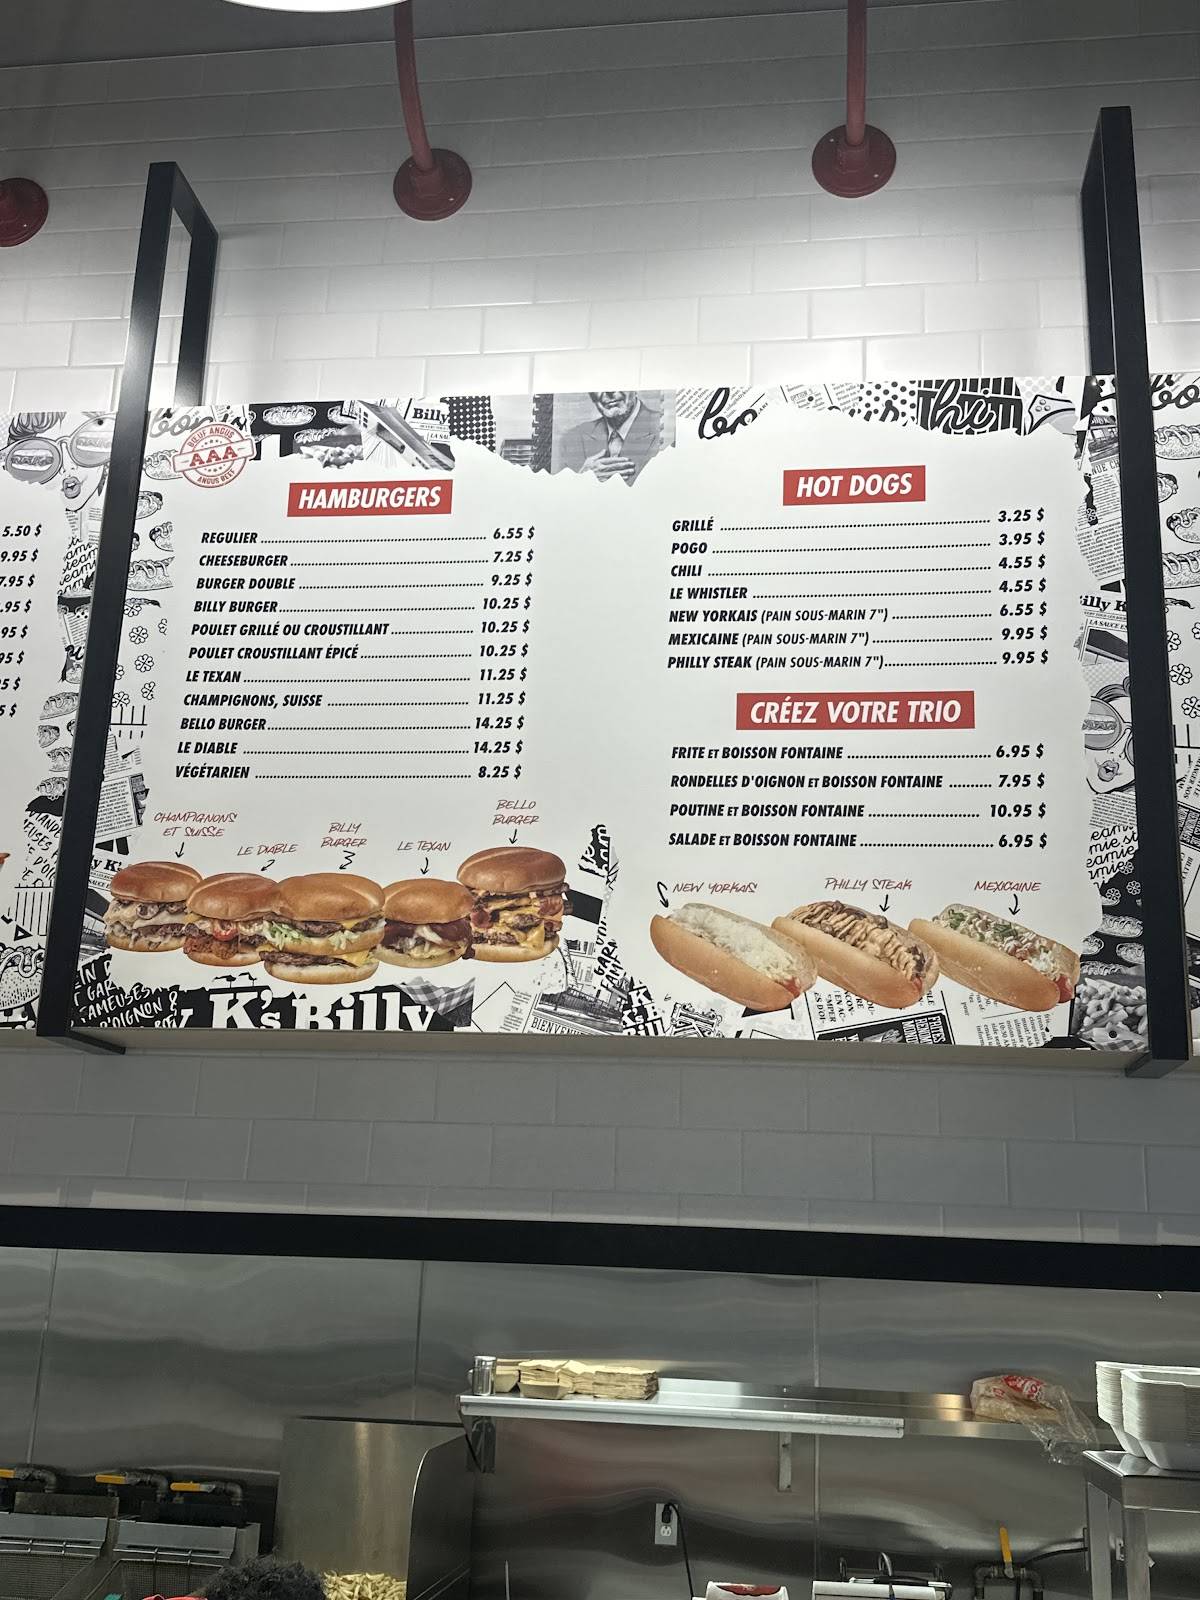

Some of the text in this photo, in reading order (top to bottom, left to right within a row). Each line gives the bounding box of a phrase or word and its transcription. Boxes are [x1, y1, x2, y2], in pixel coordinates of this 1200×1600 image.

[413, 408, 449, 424] Billy
[210, 427, 235, 438] ANGUS
[189, 446, 237, 466] AAA
[197, 469, 235, 484] ANGUS BEEF
[797, 473, 912, 497] HOT DOGS
[299, 486, 441, 509] HAMBURGERS
[673, 507, 1044, 531] GRILLÉ 3.25 $
[2, 524, 41, 537] 5.50 $
[201, 526, 534, 543] REGULIER 6.55 $
[672, 531, 1044, 554] POGO 3.95 $
[1, 549, 38, 562] 9.95 $
[200, 549, 533, 566] CHEESEBURGER 7.25 $
[671, 554, 1045, 576] CHILI 4.55 $
[28, 574, 35, 587] $
[197, 573, 532, 589] BURGER DOUBLE 9.25 $
[670, 578, 1046, 599] LE WHISTLER 4.55 $
[0, 599, 31, 613] .95 $
[194, 596, 531, 612] BILLY BURGER 10.25 $
[1080, 595, 1111, 612] illy
[669, 611, 698, 622] NEW
[703, 610, 757, 622] YORKAIS
[761, 610, 791, 624] (PAIN
[795, 610, 866, 621] SOUS-MARIN
[1000, 604, 1033, 616] 6.55
[1040, 601, 1046, 616] $
[21, 625, 28, 638] $
[192, 619, 529, 635] POULET GRILLÉ OU CROUSTILLANT 10.25 $
[668, 633, 739, 645] MEXICAINE
[743, 634, 772, 647] (PAIN
[777, 633, 847, 644] SOUS-MARIN
[1002, 627, 1034, 640] 9.95
[1040, 625, 1047, 640] $
[17, 651, 24, 664] $
[189, 643, 528, 659] POULET CROUSTILLANT ÉPICÉ 10.25 $
[668, 657, 710, 668] PHILLY
[714, 656, 752, 668] STEAK
[756, 657, 786, 670] (PAIN
[790, 657, 861, 667] SOUS-MARIN
[1003, 651, 1034, 664] 9.95
[1041, 649, 1048, 664] $
[186, 667, 527, 682] LE TEXAN 11.25 $
[13, 677, 20, 691] $
[184, 691, 525, 709] CHAMPIGNONS, SUISSE 11.25 $
[9, 703, 16, 717] $
[751, 696, 961, 723] CRÉEZ VOTRE TRIO
[180, 716, 524, 730] BELLO BURGER 14.25 $
[178, 740, 523, 754] LE DIABLE 14.25 $
[672, 743, 1043, 758] FRITE ET BOISSON FONTAINE 6.95 $
[176, 763, 521, 779] VÉGÉTARIEN 8.25 $
[671, 773, 1044, 788] RONDELLES D'OIGNON ET BOISSON FONTAINE 7.95 $
[496, 800, 536, 810] BELLO
[670, 803, 1045, 818] POUTINE ET BOISSON FONTAINE 10.95 $
[154, 812, 237, 823] CHAMPIGNONS
[493, 814, 539, 825] BURGER
[163, 826, 224, 837] ET SUISSE
[329, 823, 361, 834] BILLY
[321, 837, 367, 848] BURGER
[397, 841, 451, 852] LE TEXAN
[669, 833, 1047, 849] SALADE ET BOISSON FONTAINE 6.95 $
[237, 844, 297, 856] LE DIABLE
[673, 882, 757, 894] NEW YORKAIS
[825, 878, 912, 891] PHILLY STEAK
[974, 881, 1041, 892] MEXICAINE
